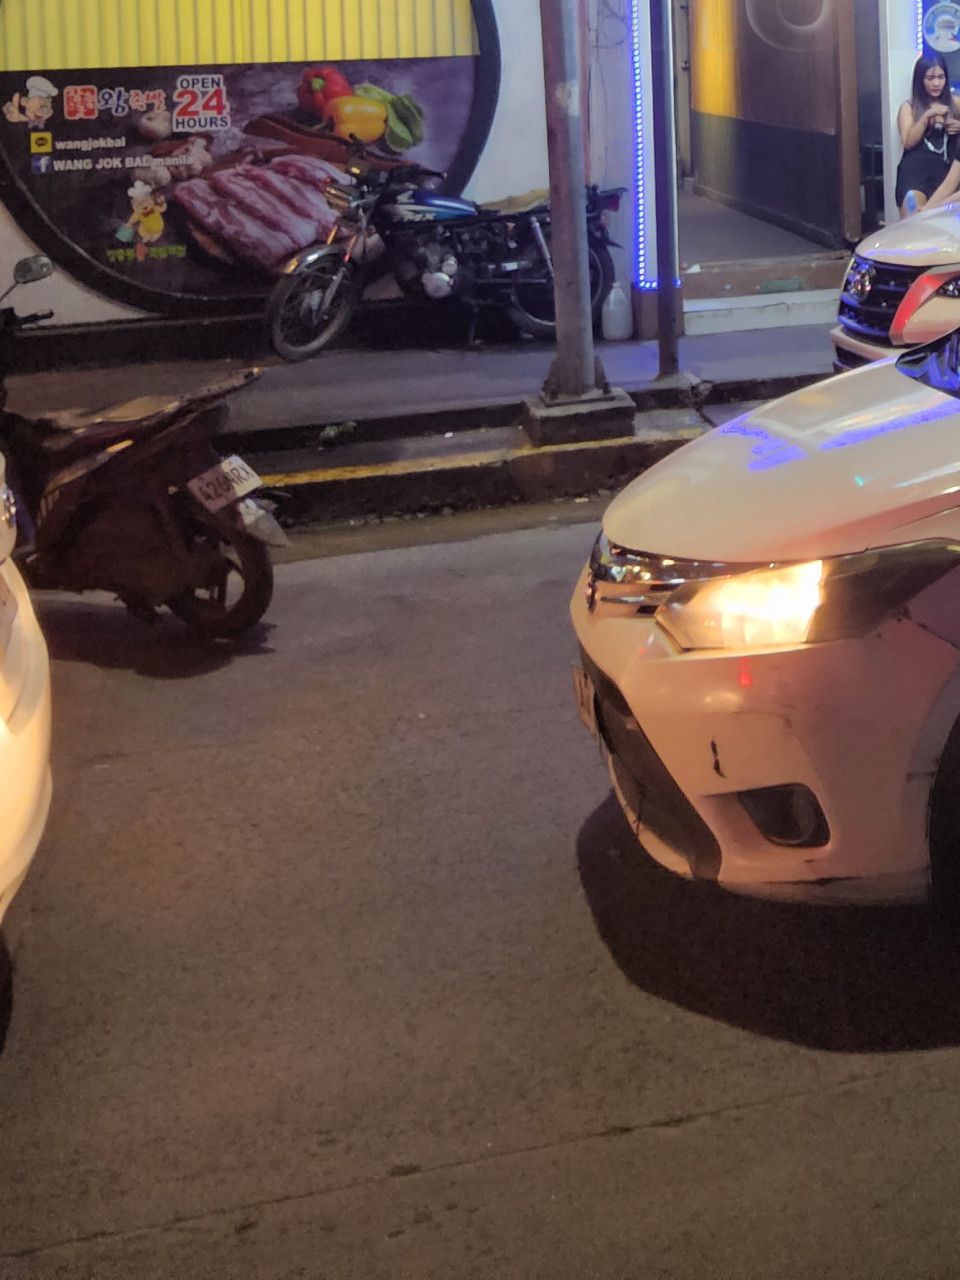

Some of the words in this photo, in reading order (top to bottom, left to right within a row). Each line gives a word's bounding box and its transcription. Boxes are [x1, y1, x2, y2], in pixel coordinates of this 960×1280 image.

[179, 77, 221, 89] OPEN
[174, 88, 227, 117] 24
[174, 116, 229, 129] HOURS
[53, 159, 93, 171] WANG
[95, 158, 123, 169] JOK
